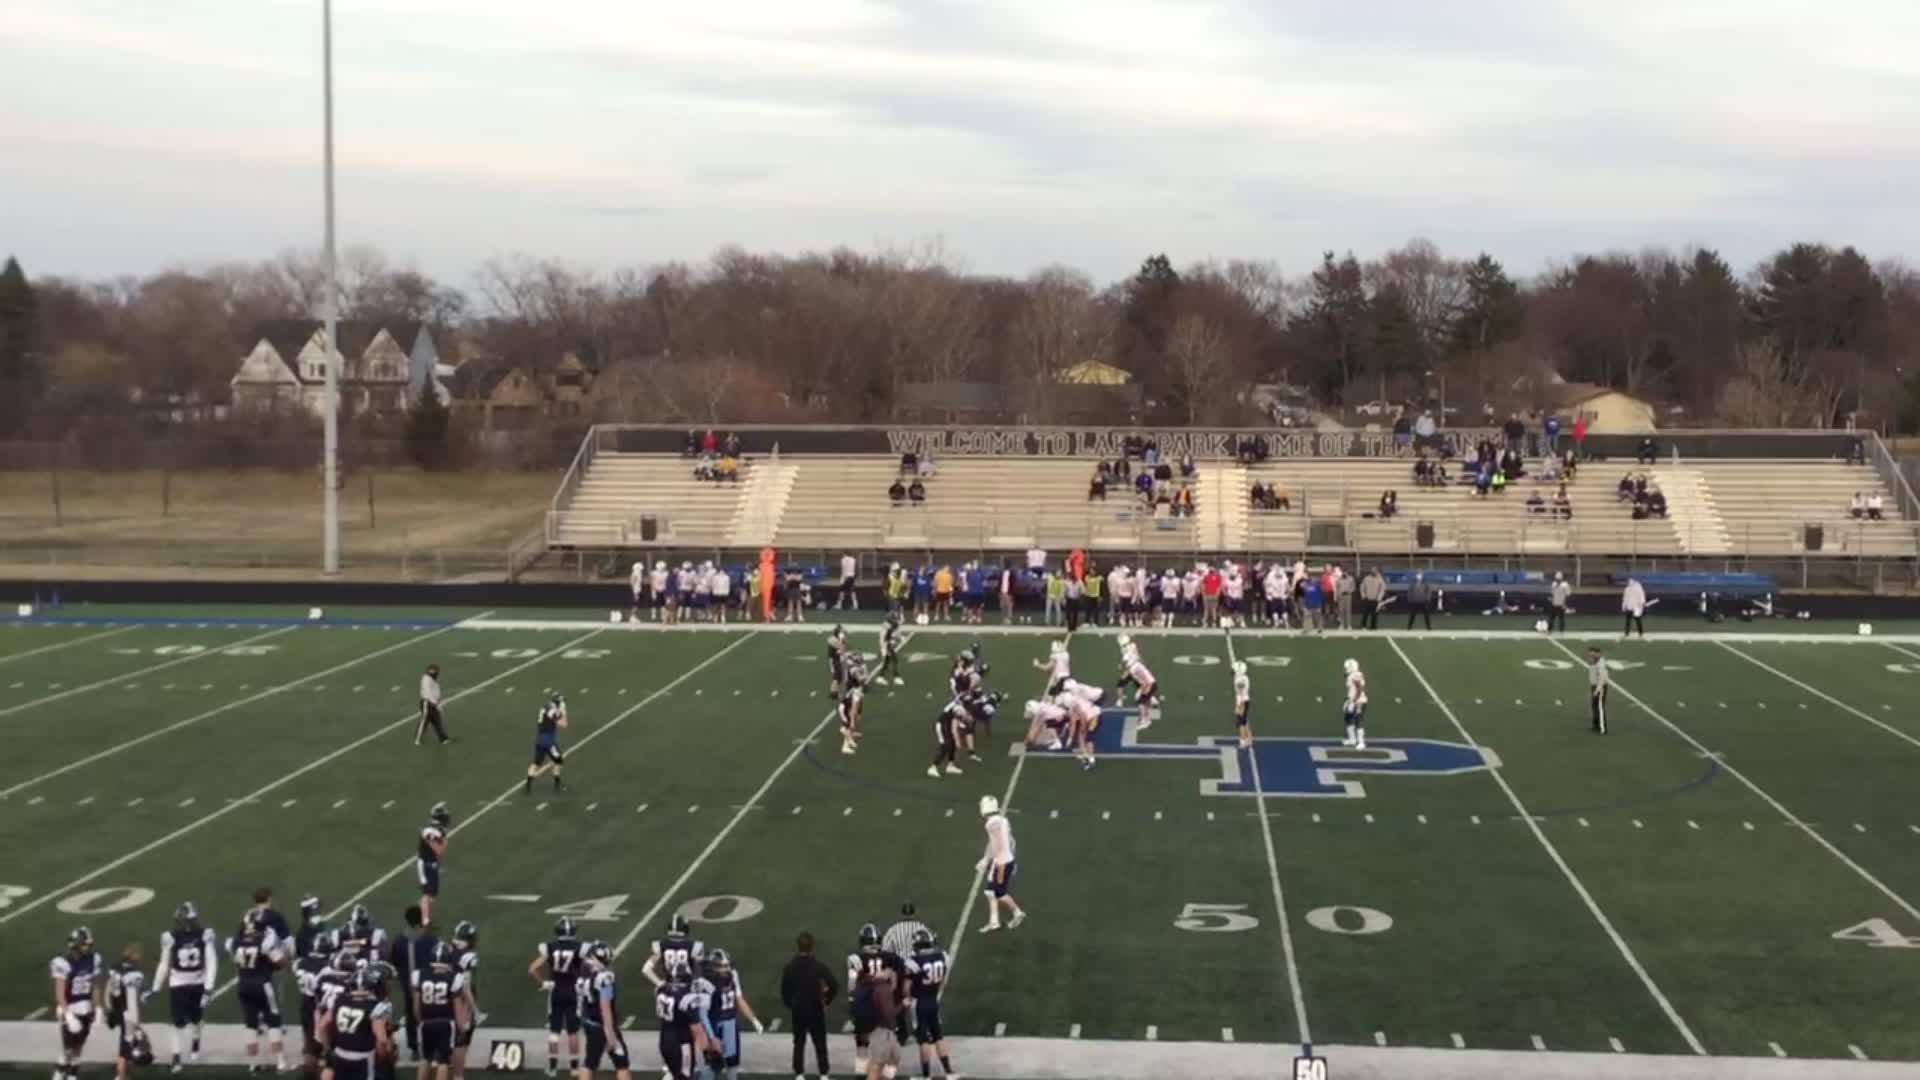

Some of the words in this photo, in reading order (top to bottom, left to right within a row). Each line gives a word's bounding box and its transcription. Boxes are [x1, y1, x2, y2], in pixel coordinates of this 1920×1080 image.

[888, 431, 1027, 455] WELCOME
[1034, 432, 1070, 455] TO
[1155, 433, 1230, 456] PARK
[1318, 432, 1354, 457] OF
[545, 894, 764, 923] 40
[1173, 903, 1394, 934] 50
[552, 949, 574, 973] 17
[922, 960, 944, 985] 30
[421, 980, 448, 1005] 82
[336, 1005, 365, 1033] 67
[491, 1042, 522, 1071] 40
[1296, 1058, 1327, 1080] 50
